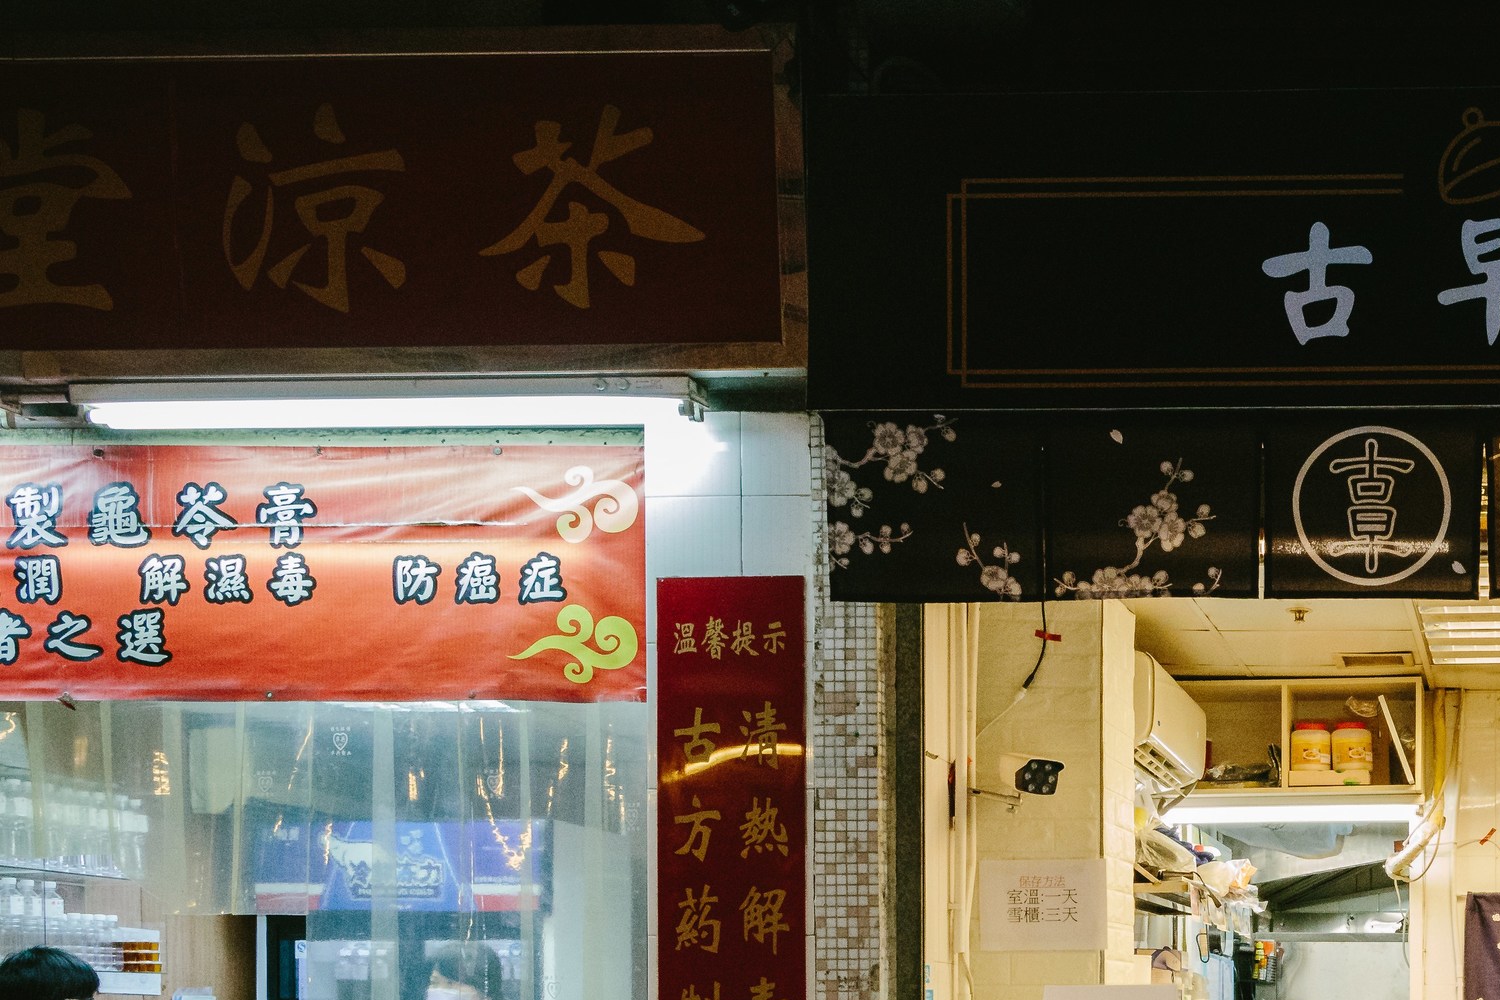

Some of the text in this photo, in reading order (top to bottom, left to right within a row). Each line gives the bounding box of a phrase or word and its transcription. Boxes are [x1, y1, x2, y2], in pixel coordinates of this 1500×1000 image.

[8, 483, 316, 548] 製龜苓膏
[16, 552, 569, 605] 潤 解濕毒 防癌症
[1019, 875, 1066, 889] 保存方法
[1007, 889, 1078, 905] 室溫:一天
[1007, 907, 1078, 923] 雪櫃:三天
